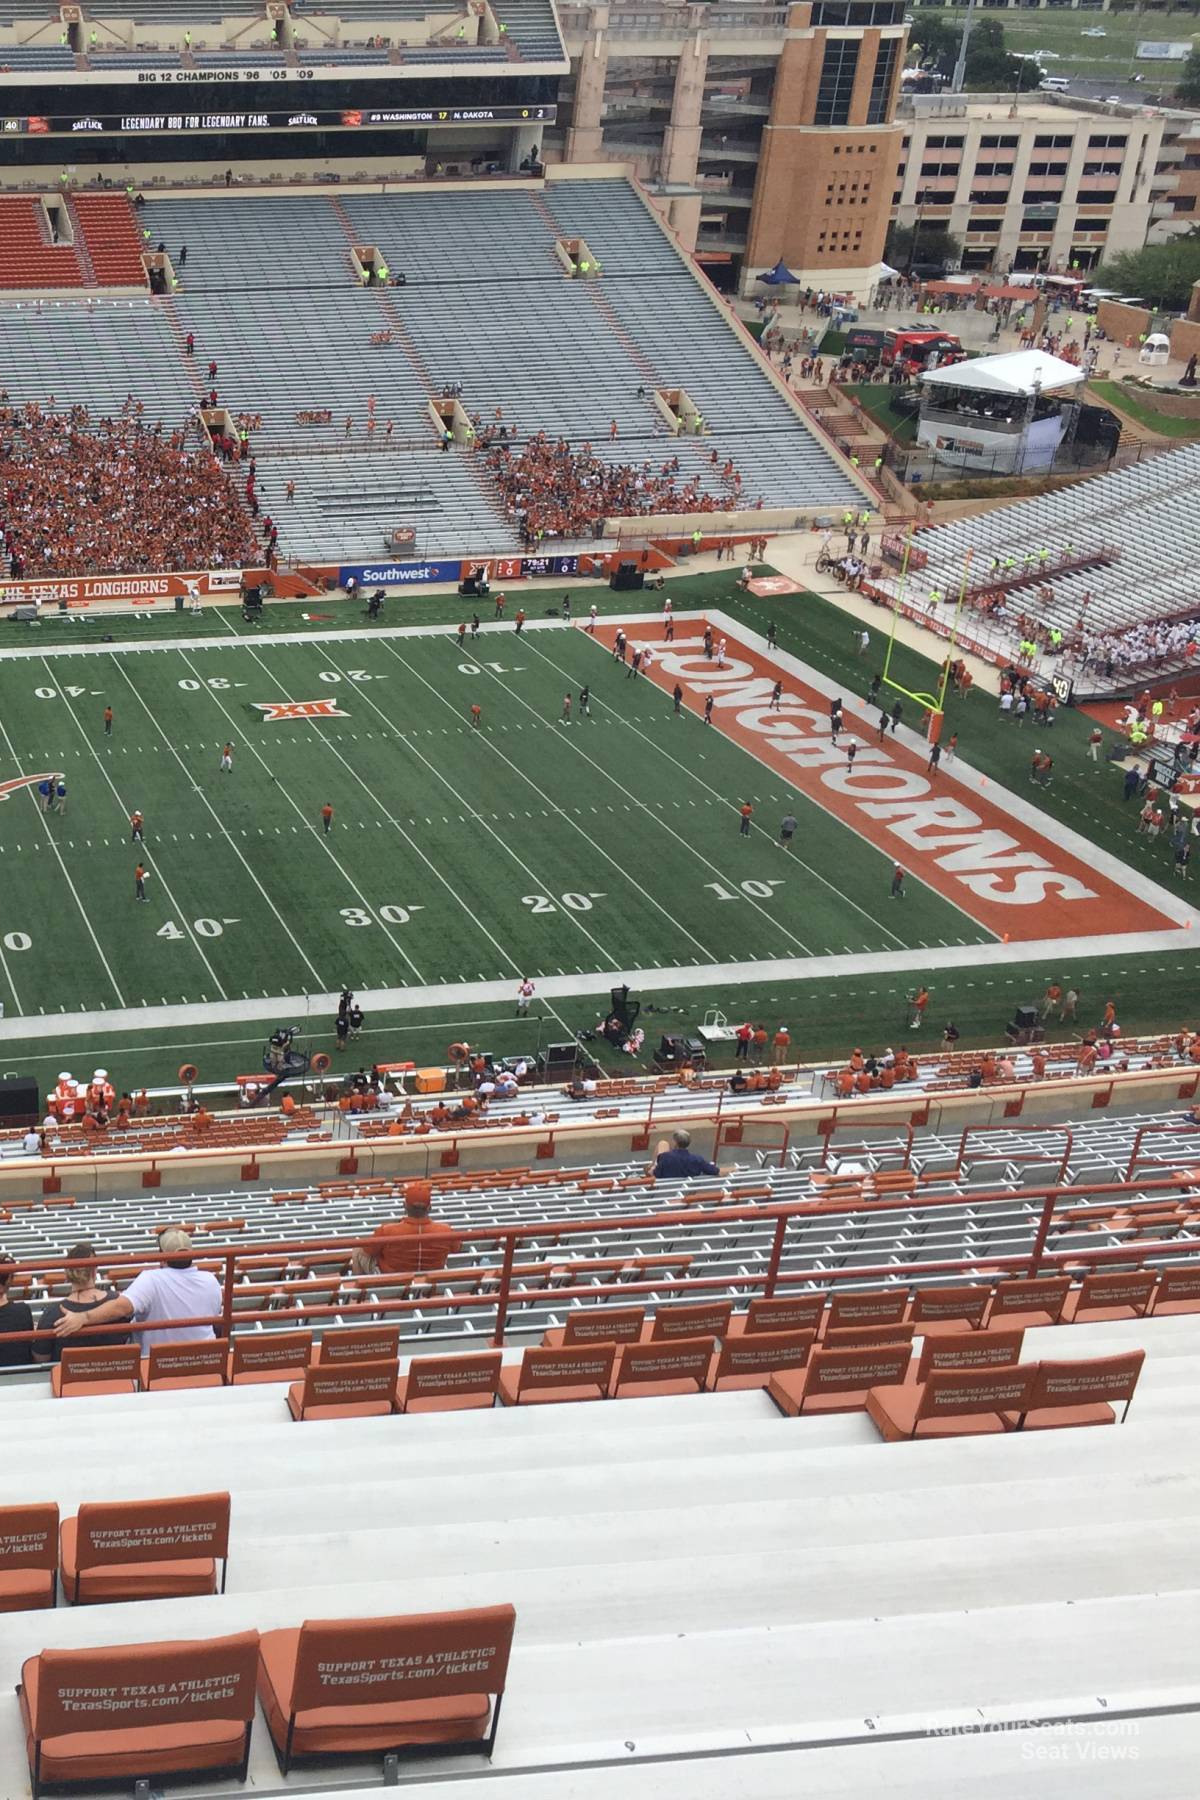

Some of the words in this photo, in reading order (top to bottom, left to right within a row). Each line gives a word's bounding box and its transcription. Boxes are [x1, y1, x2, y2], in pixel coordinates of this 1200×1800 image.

[138, 73, 156, 82] BIG
[161, 73, 171, 81] 12
[176, 72, 239, 81] CHAMPIONS
[243, 72, 259, 80] '96
[270, 71, 287, 79] '05
[296, 71, 313, 79] '09
[383, 113, 432, 121] WASHINGTON
[438, 111, 447, 120] 17
[463, 110, 493, 119] DAKOTA
[522, 110, 528, 118] 0
[537, 109, 544, 118] 2
[121, 118, 164, 130] LEGENDARY
[185, 117, 199, 128] FOR
[202, 116, 245, 128] LEGENDARY
[248, 115, 270, 127] FANS.
[363, 566, 430, 581] Southwest
[28, 583, 78, 600] TEXAS
[85, 579, 169, 597] LONGHORNS
[318, 669, 373, 683] 20
[457, 661, 510, 675] 10
[34, 685, 86, 699] 40
[177, 677, 231, 691] 30
[1053, 678, 1068, 698] 40
[630, 636, 1099, 905] LONGHORNS
[1154, 762, 1177, 779] MUSCLE
[703, 880, 774, 900] 10
[521, 892, 593, 913] 20
[339, 905, 410, 926] 30
[156, 918, 223, 940] 40
[90, 1530, 131, 1539] SUPPORT
[134, 1526, 164, 1536] TEXAS
[167, 1522, 216, 1535] ATHLETICS
[318, 1660, 375, 1672] SUPPORT
[379, 1655, 422, 1668] TEXAS
[426, 1647, 496, 1664] ATHLETICS
[320, 1660, 488, 1686] TexasSports.com/tickets
[58, 1686, 116, 1698] SUPPORT
[122, 1683, 165, 1696] TEXAS
[170, 1673, 241, 1692] ATHLETICS
[62, 1686, 234, 1712] TexasSports.com/tickets
